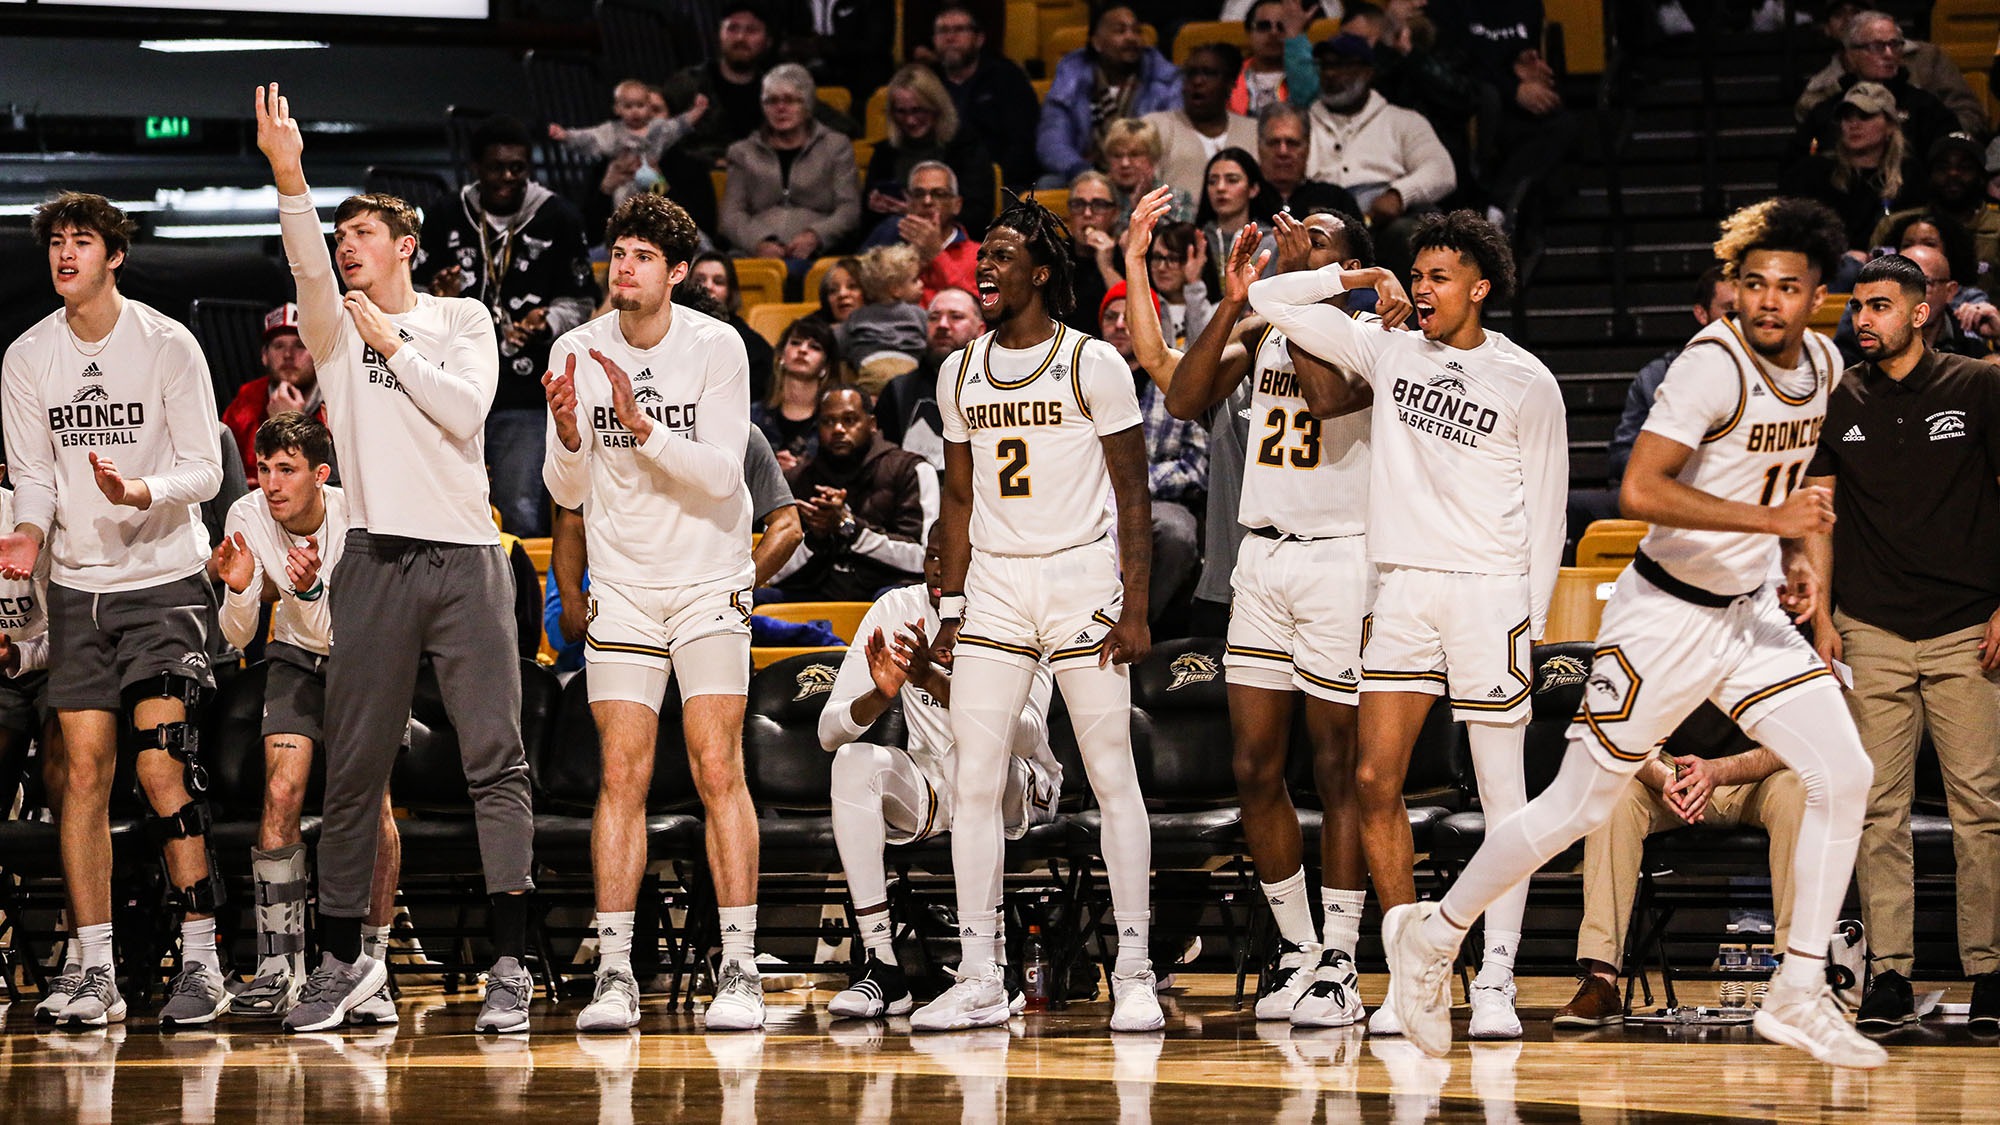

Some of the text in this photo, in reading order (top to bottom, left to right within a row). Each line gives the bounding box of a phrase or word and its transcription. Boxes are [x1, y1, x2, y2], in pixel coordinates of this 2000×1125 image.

[48, 402, 144, 431] BRONCO
[594, 403, 696, 430] BRNCO
[965, 401, 1062, 430] BRONCOS
[1392, 378, 1498, 434] BRONCO
[1256, 406, 1322, 471] 23
[996, 437, 1032, 499] 2
